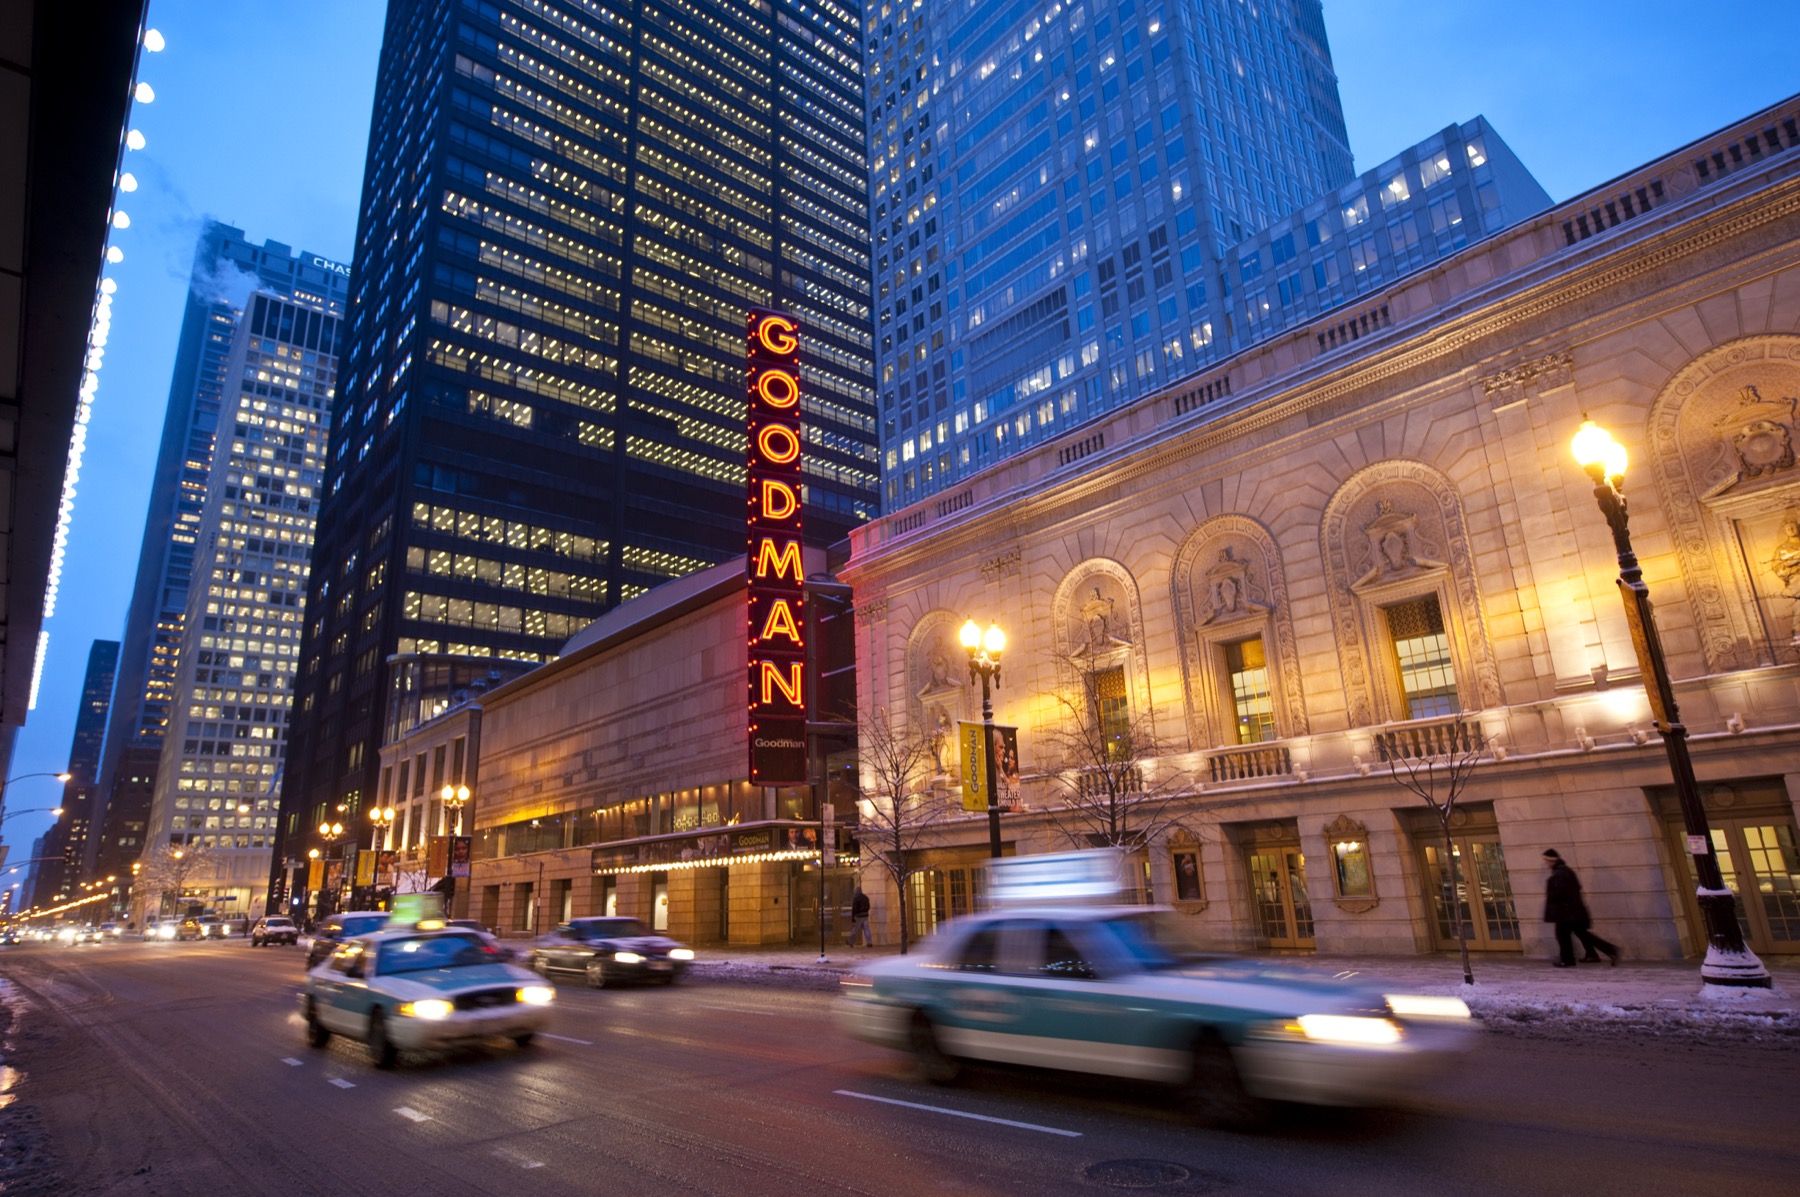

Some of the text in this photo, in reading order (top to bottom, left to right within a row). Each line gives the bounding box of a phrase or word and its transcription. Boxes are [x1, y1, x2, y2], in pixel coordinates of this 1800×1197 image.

[757, 316, 804, 705] GOODMAN
[755, 738, 805, 748] Goodman
[970, 730, 979, 793] GOODMAN
